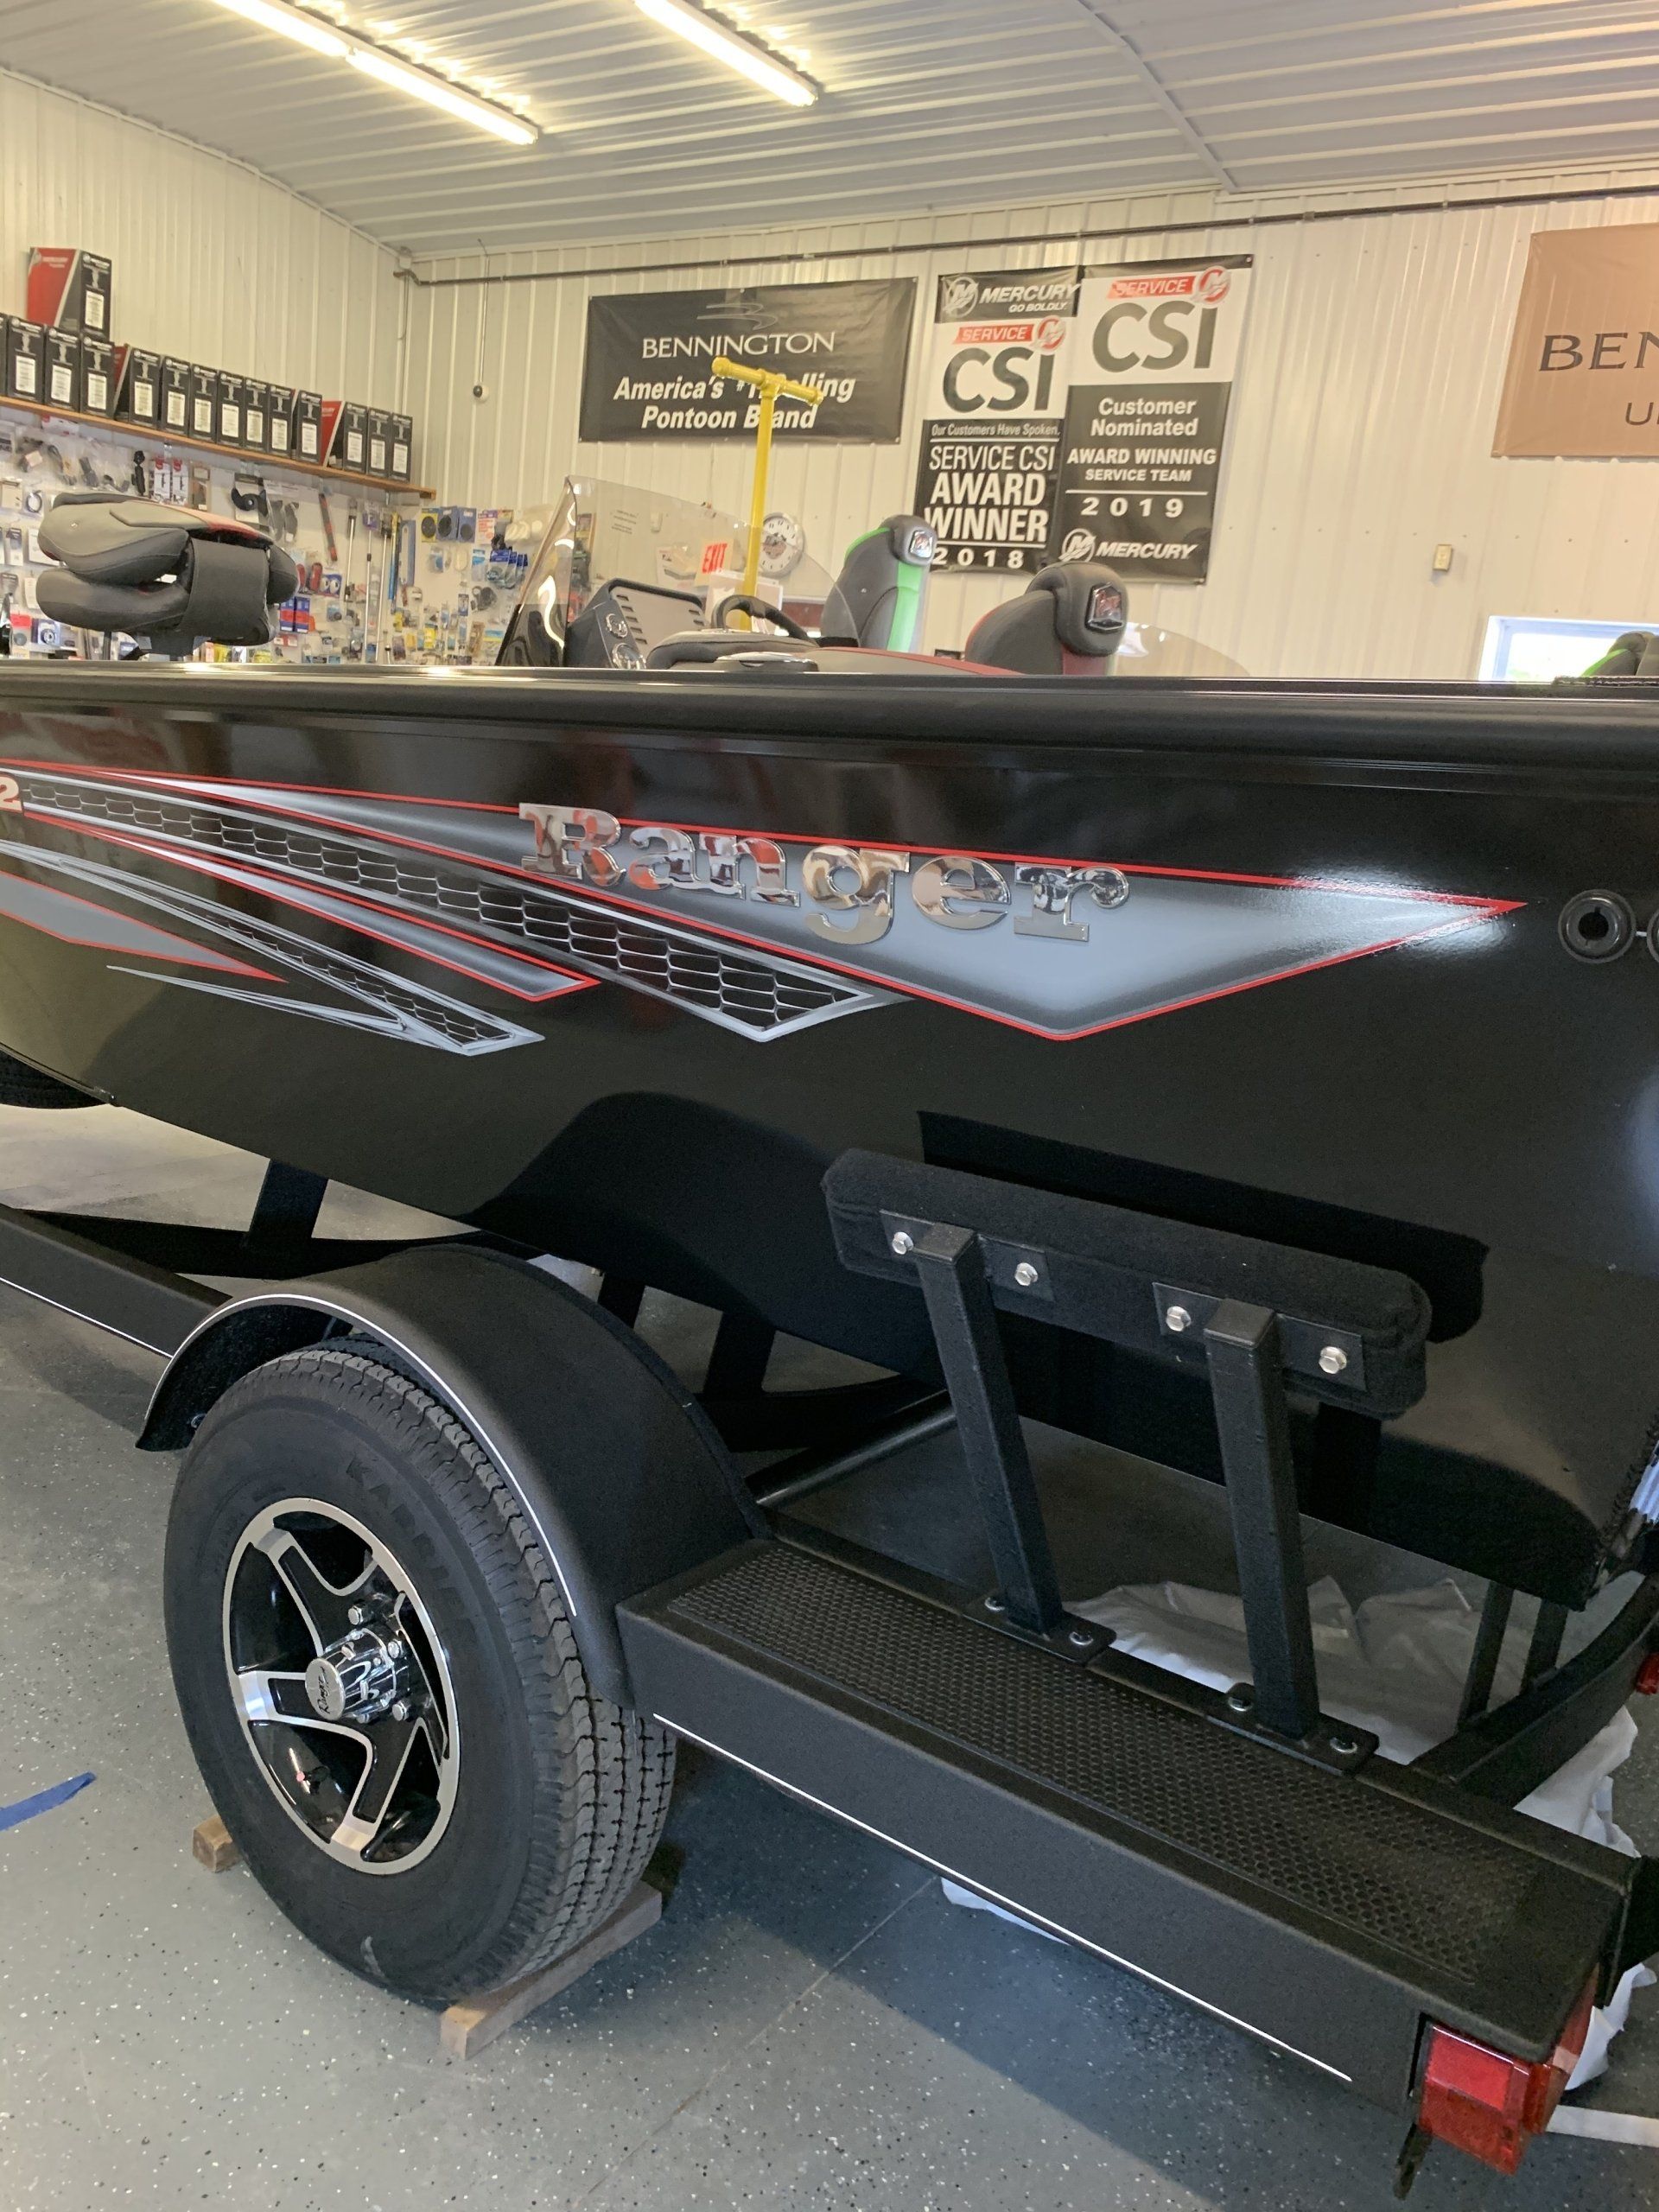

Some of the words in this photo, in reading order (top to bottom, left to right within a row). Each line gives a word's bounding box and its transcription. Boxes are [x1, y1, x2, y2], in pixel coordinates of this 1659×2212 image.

[979, 283, 1081, 303] MERCURY
[1115, 279, 1189, 295] SERVICE
[1008, 304, 1025, 314] GO
[962, 327, 1028, 341] SERVICE
[642, 332, 836, 359] BENNINGTON
[613, 375, 725, 401] America's
[641, 404, 737, 429] Pontoon
[743, 403, 818, 429] Band
[1098, 397, 1197, 416] Customer
[931, 423, 947, 436] Our
[947, 423, 995, 436] Customers
[997, 423, 1020, 435] Have
[1090, 417, 1199, 436] Nominated
[929, 446, 1016, 471] SERVICE
[1019, 446, 1056, 472] CSI
[1067, 448, 1130, 464] AWARD
[1135, 448, 1217, 465] WINNING
[1085, 468, 1147, 481] SERVICE
[1150, 469, 1193, 482] TEAM
[930, 472, 1046, 506] AWARD
[1081, 497, 1184, 518] 2019
[924, 507, 1049, 543] WINNER
[702, 543, 728, 574] EXIT
[933, 547, 1024, 569] 2018
[1096, 542, 1198, 559] MERCURY
[519, 803, 1130, 945] Ranger
